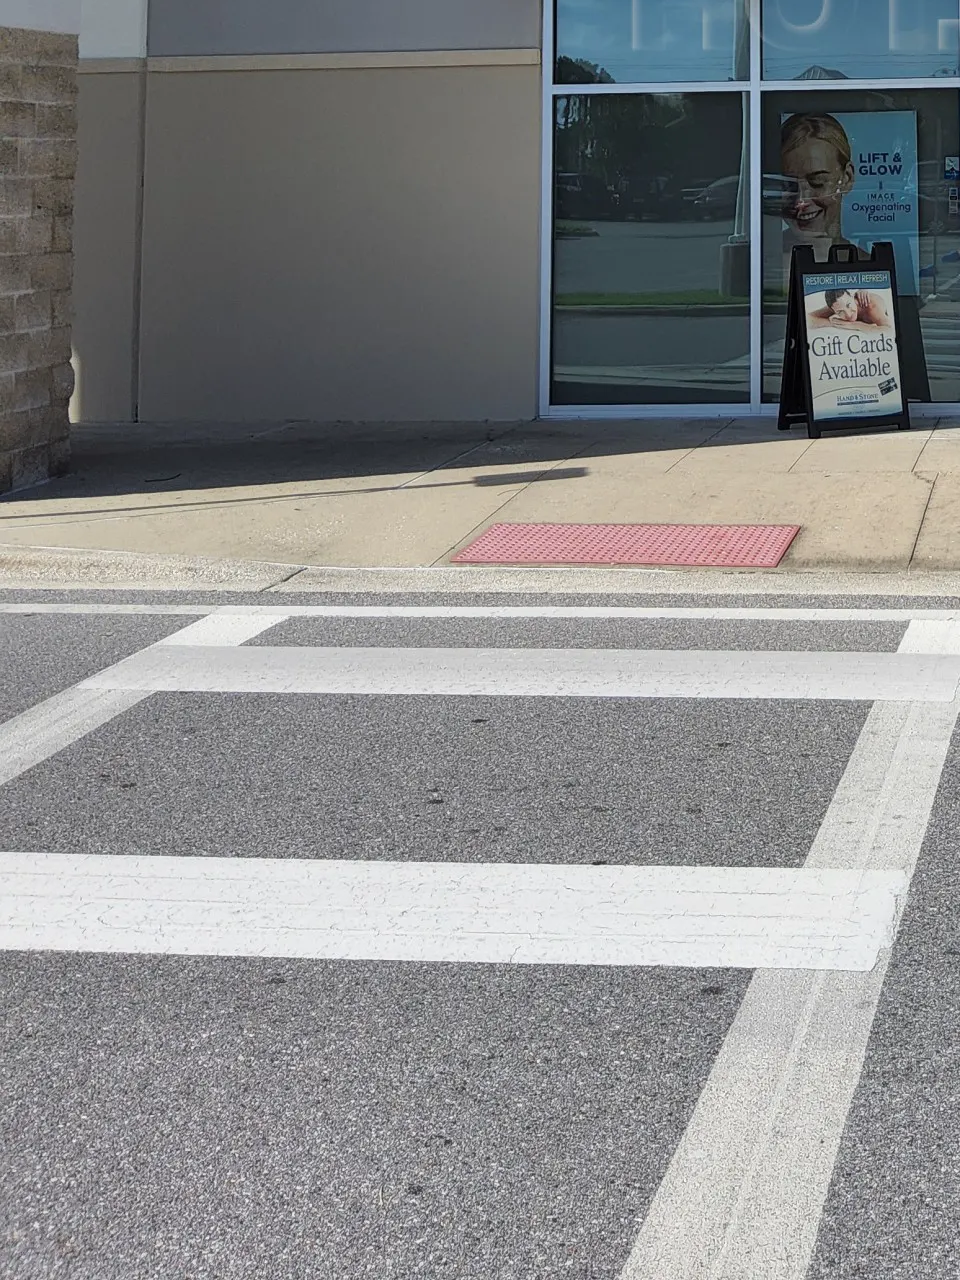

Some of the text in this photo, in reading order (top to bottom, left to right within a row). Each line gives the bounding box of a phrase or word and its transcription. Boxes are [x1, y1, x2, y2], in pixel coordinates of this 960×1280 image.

[859, 152, 902, 164] LIFT &
[859, 164, 902, 176] GLOW
[852, 202, 911, 214] Oxygenating
[868, 213, 896, 222] Facial
[805, 273, 888, 286] RESTORE RELAX REFRESH
[811, 333, 893, 358] Gift Cards
[818, 357, 891, 381] Available
